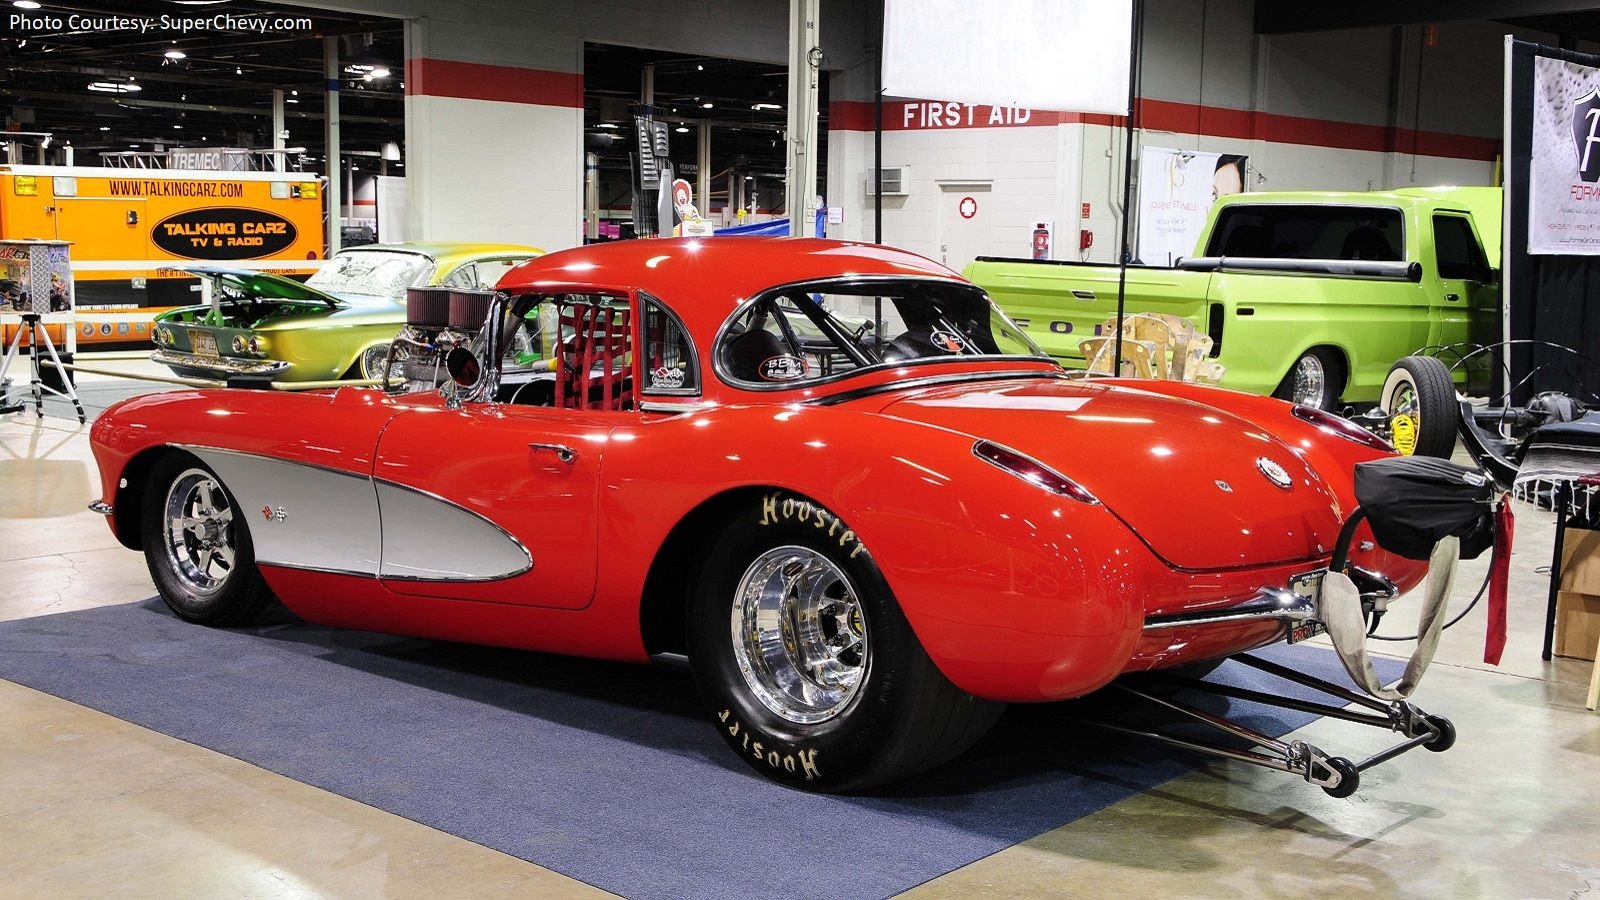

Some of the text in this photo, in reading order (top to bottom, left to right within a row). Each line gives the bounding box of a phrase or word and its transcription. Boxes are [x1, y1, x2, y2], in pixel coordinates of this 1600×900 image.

[903, 102, 1031, 128] FIRST AID
[173, 152, 220, 170] TREMEC
[109, 180, 243, 198] WWW.TALKINGCARZ.COM
[163, 222, 287, 236] TALKING CARZ
[190, 237, 263, 247] TV & RADIO
